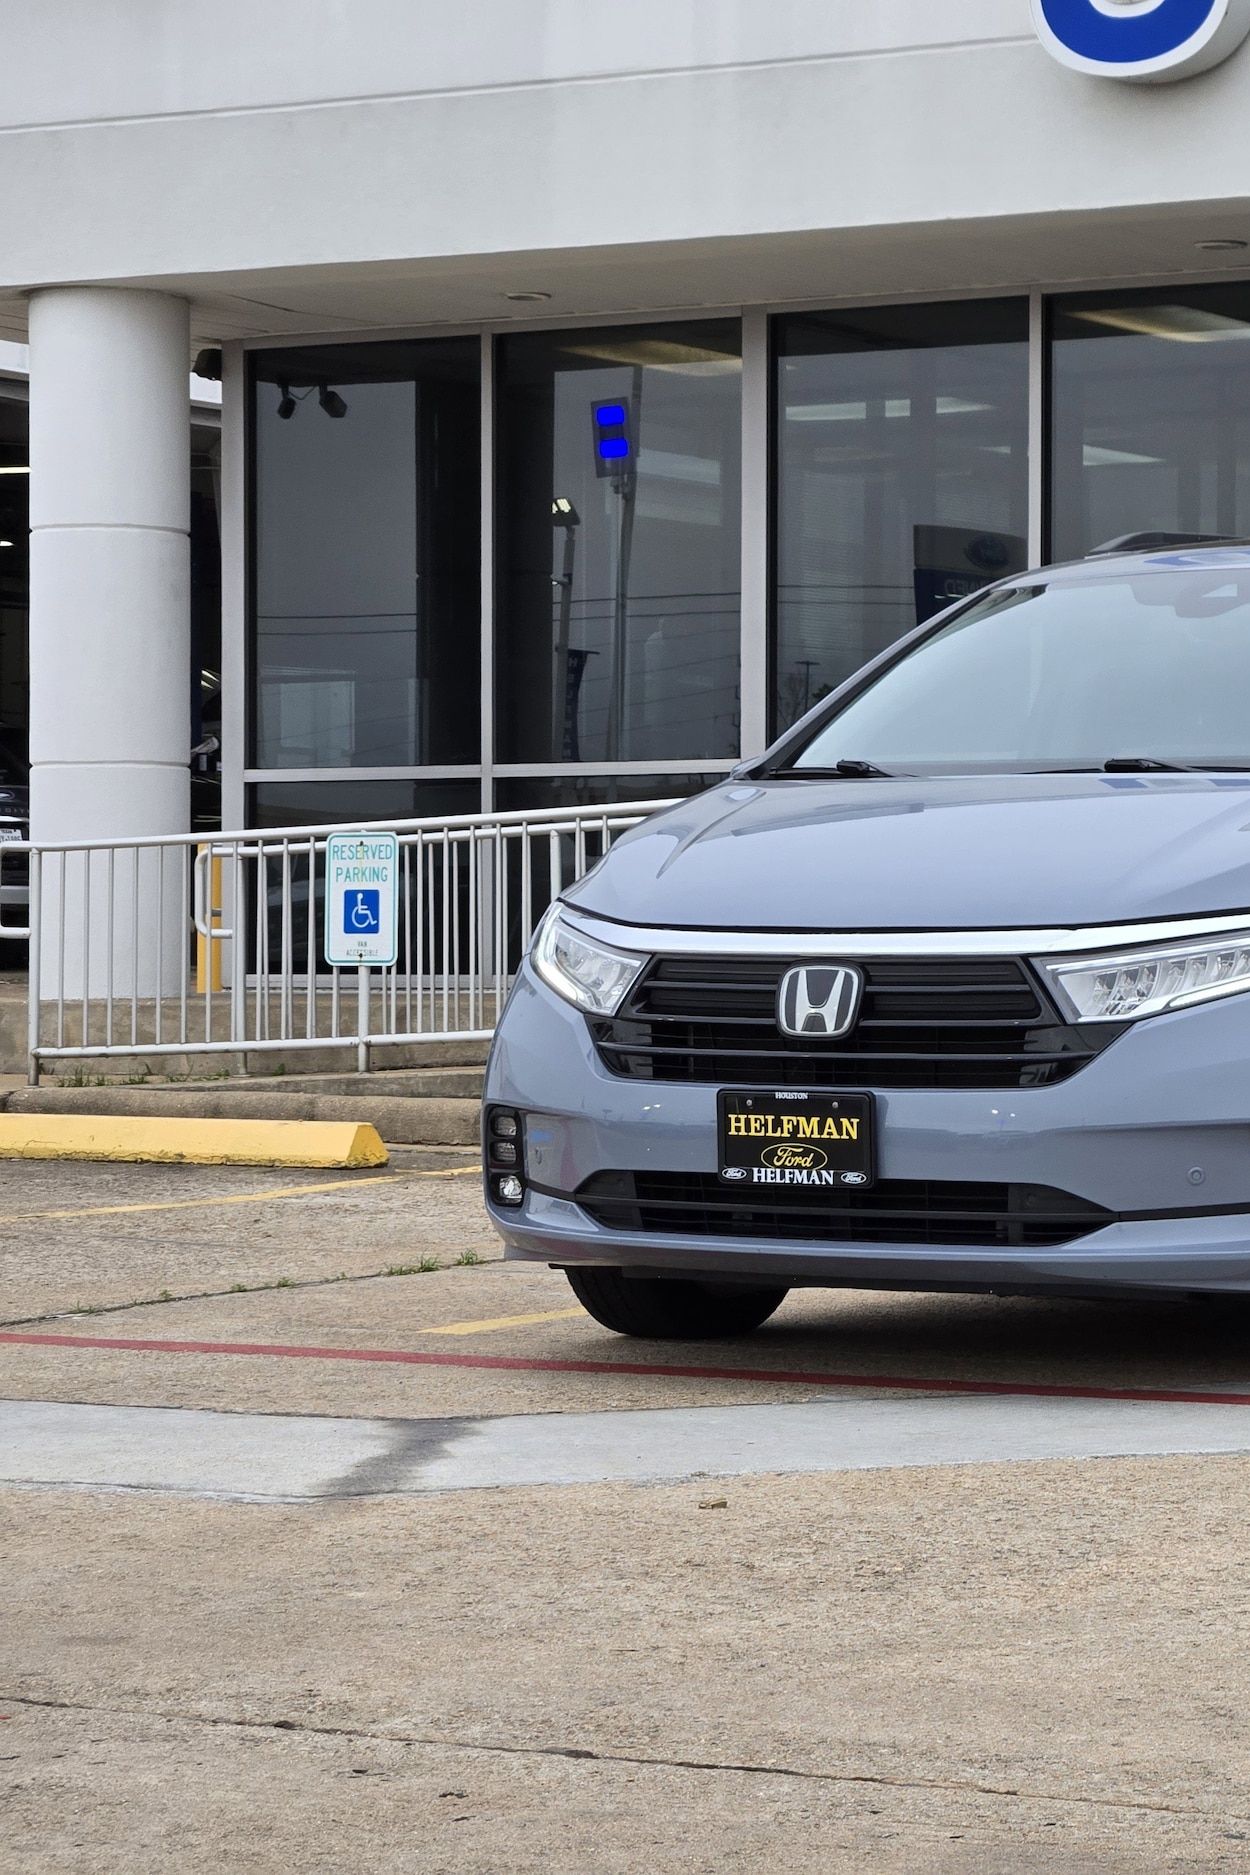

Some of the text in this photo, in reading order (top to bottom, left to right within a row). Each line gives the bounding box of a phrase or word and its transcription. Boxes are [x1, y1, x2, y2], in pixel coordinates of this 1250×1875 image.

[332, 844, 393, 860] RESERVED
[335, 867, 388, 882] PARKING
[775, 1091, 808, 1100] HOUSTON
[728, 1114, 860, 1140] HELFMAN
[773, 1146, 814, 1168] Ford
[752, 1167, 835, 1186] HELFMAN
